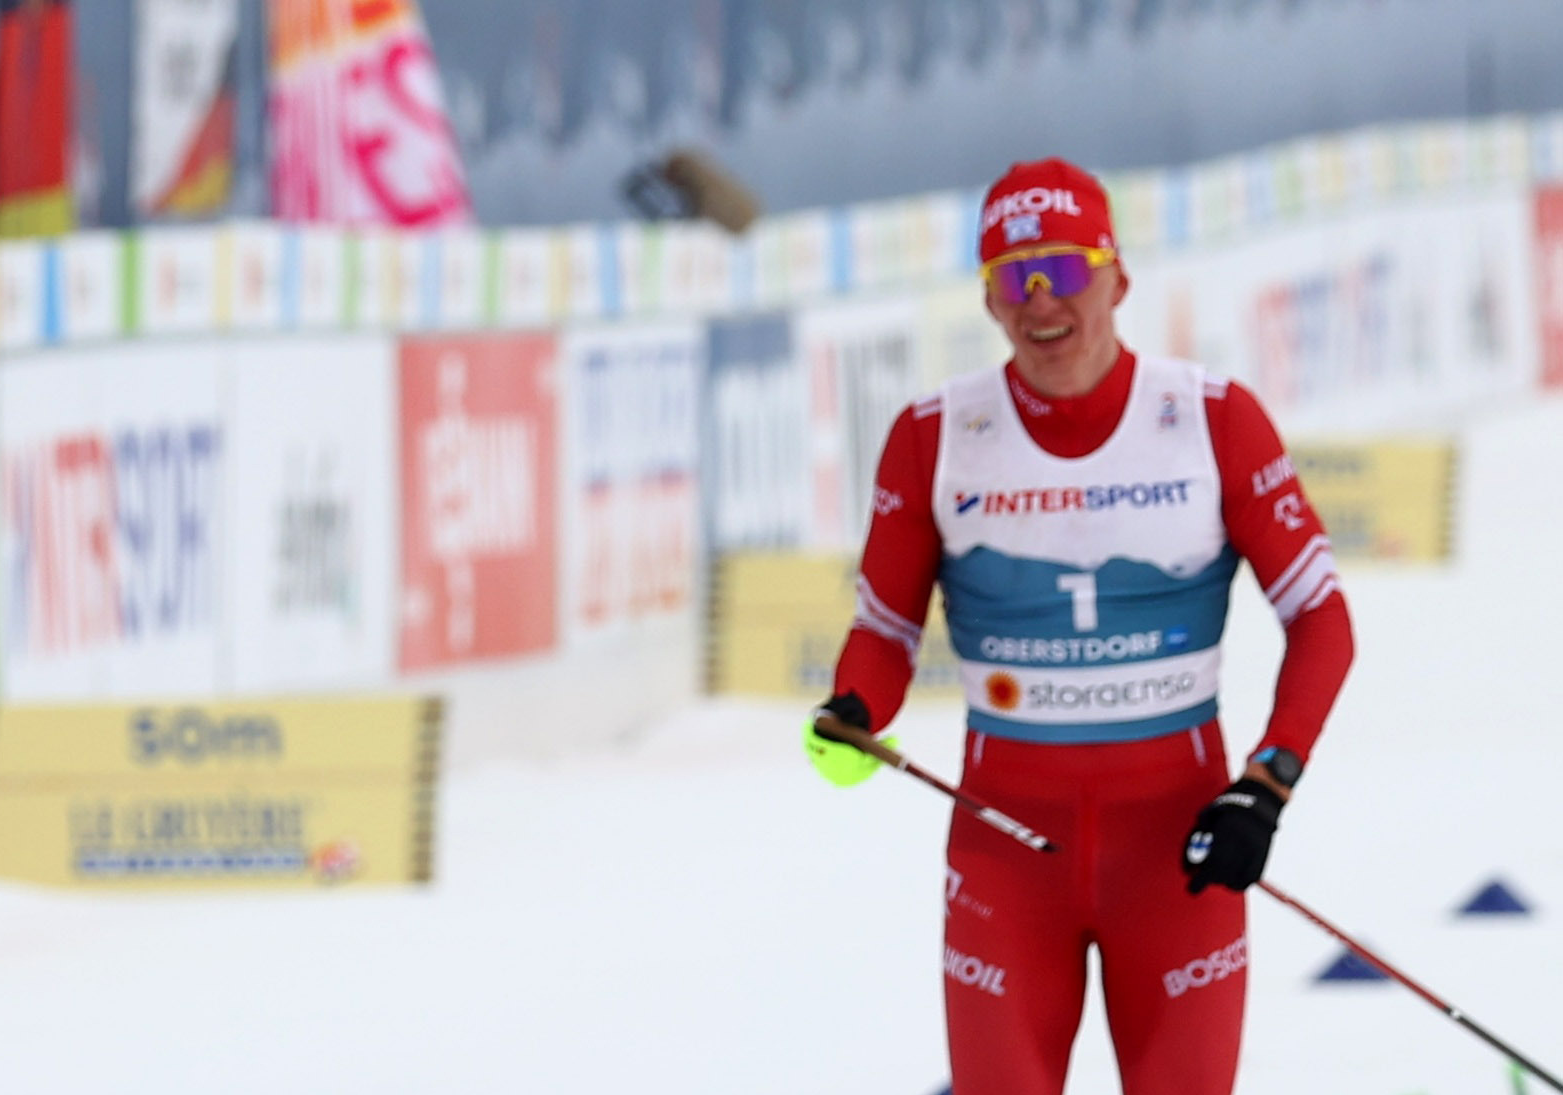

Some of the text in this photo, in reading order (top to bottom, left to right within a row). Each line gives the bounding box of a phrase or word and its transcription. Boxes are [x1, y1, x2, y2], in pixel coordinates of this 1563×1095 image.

[983, 480, 1190, 516] INTERSPORT
[1056, 573, 1099, 633] 1
[980, 632, 1163, 664] OBERSTDORF
[1026, 671, 1197, 710] storaenso
